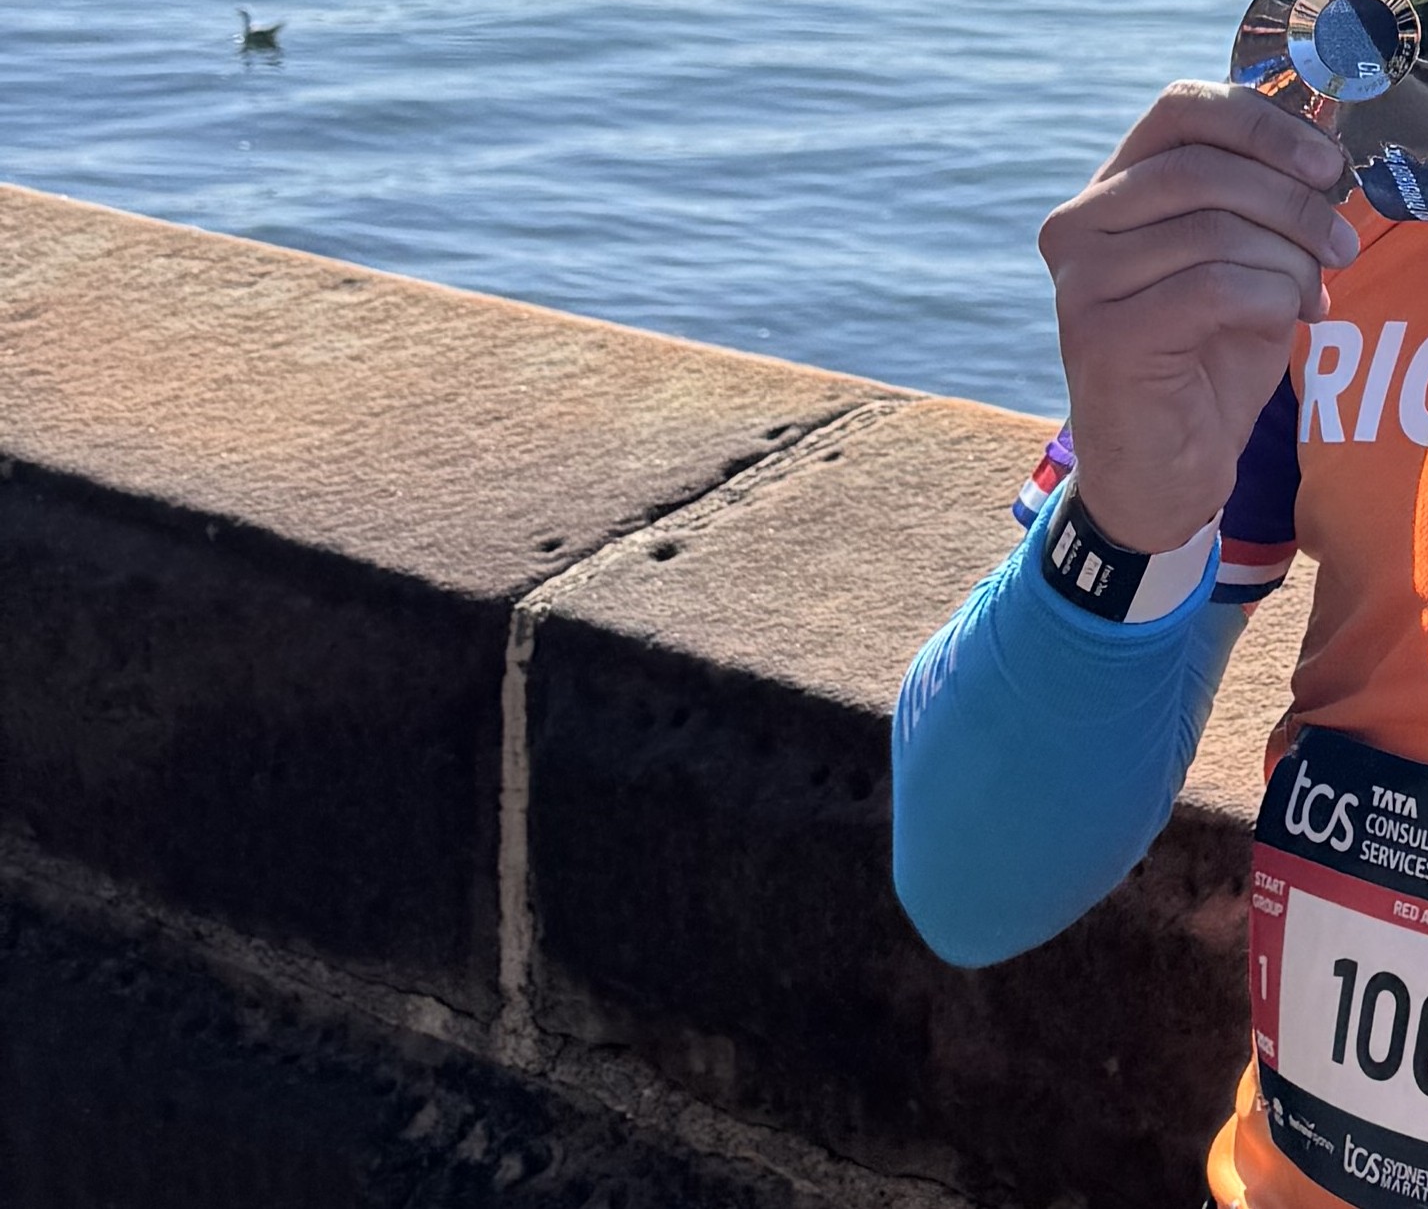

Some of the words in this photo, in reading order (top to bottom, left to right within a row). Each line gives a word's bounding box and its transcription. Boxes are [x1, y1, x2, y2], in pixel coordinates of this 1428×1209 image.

[1285, 759, 1359, 852] tcs
[1371, 785, 1418, 818] TATA
[1255, 871, 1286, 895] START
[1393, 900, 1419, 921] RED
[1258, 954, 1268, 1000] 1
[1344, 1134, 1382, 1184] tcs
